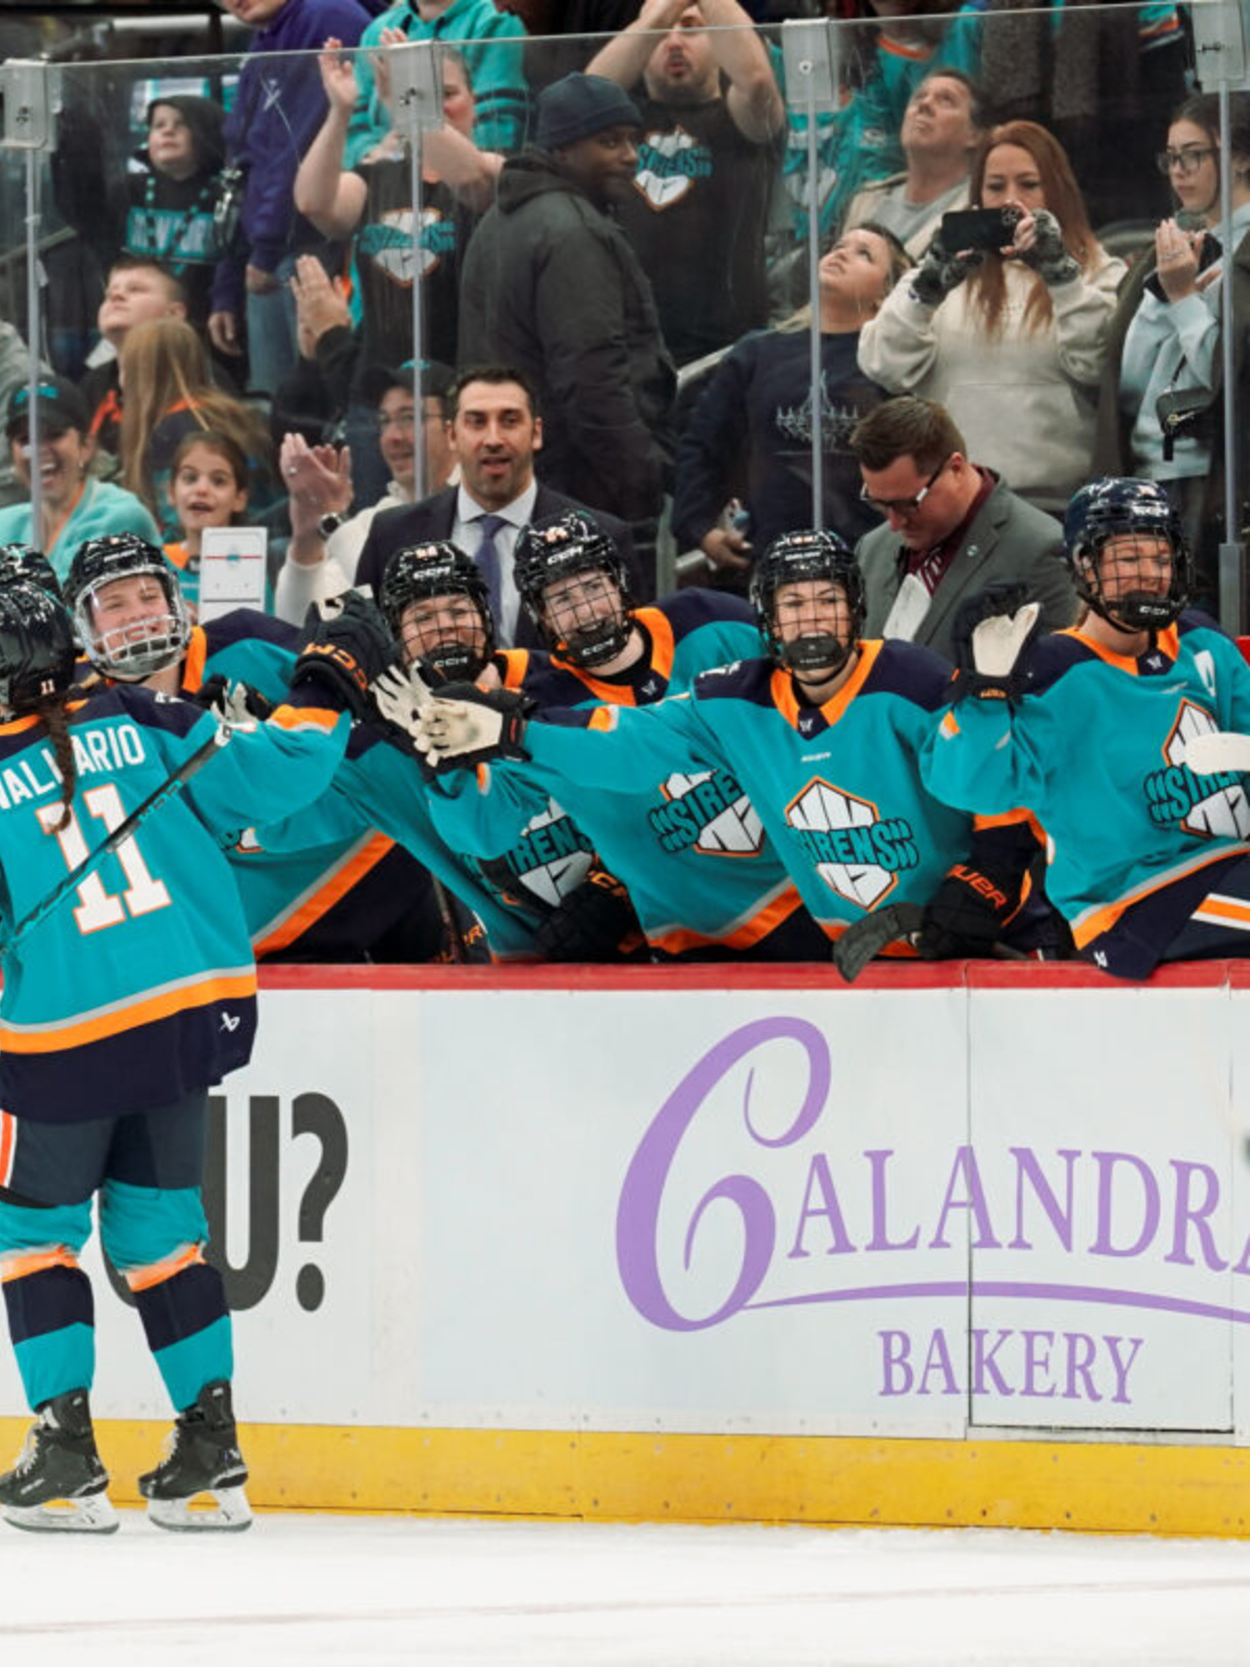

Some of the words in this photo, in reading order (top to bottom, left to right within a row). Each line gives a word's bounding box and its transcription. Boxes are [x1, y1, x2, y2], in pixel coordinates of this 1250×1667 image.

[666, 770, 746, 846] SIRE
[34, 783, 173, 935] 11
[877, 1327, 1145, 1405] BAKERY
